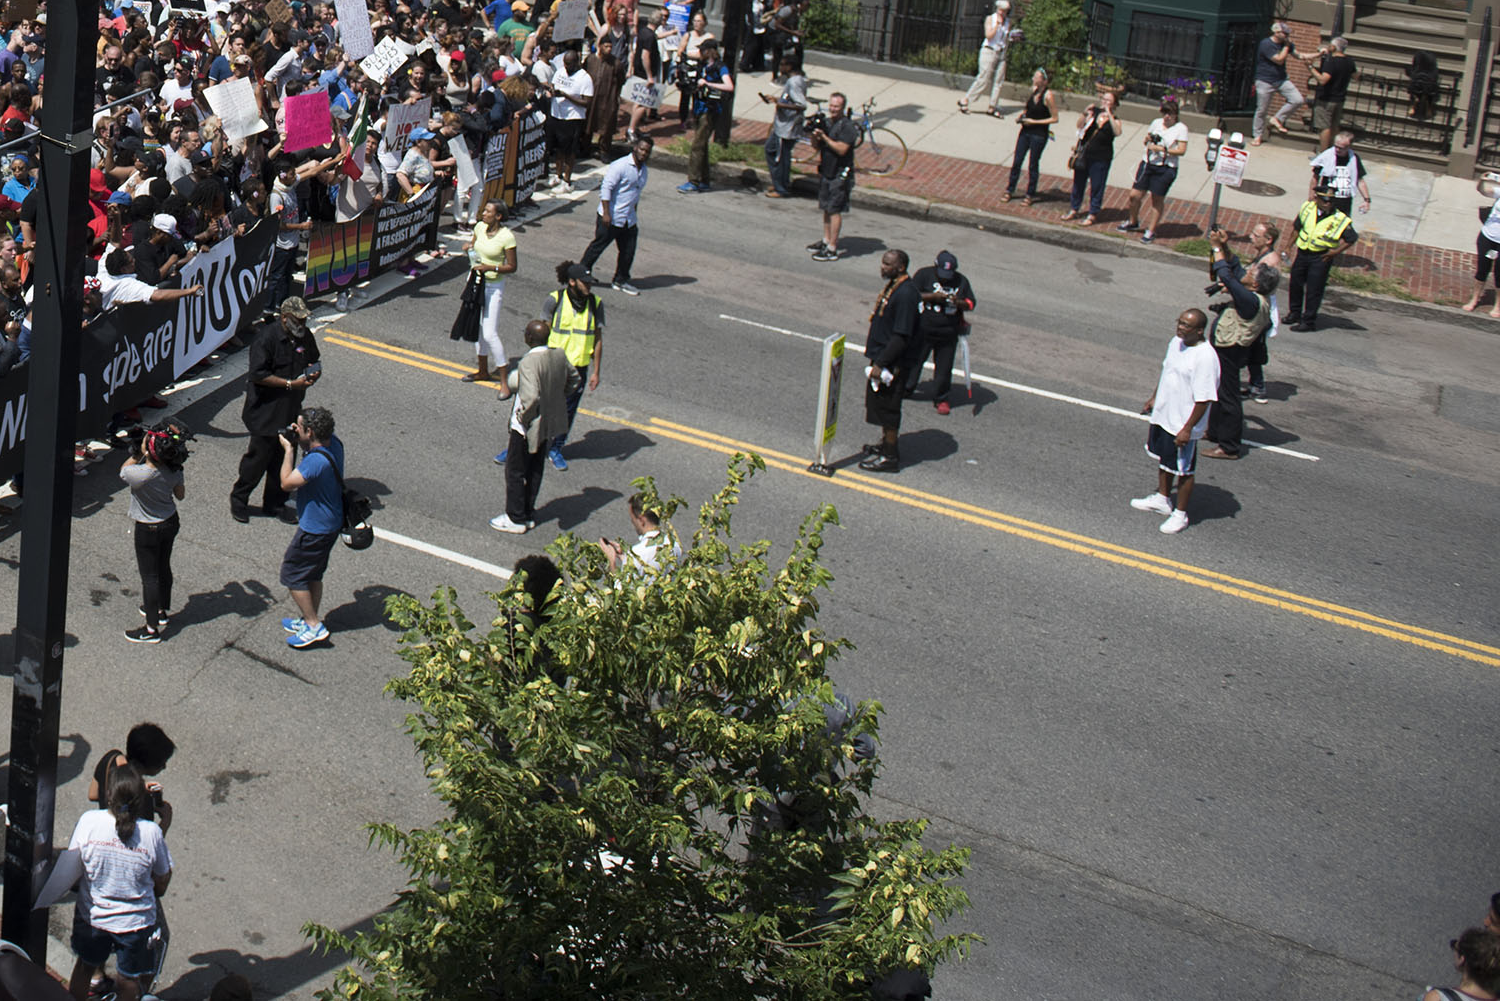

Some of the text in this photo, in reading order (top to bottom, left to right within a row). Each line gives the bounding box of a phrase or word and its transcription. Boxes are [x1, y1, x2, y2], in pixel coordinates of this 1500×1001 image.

[631, 93, 656, 108] FUCK
[396, 121, 421, 137] NOT
[381, 227, 409, 249] FASCIST
[238, 243, 276, 305] on?
[181, 254, 232, 357] YOU
[103, 335, 142, 404] side
[143, 319, 173, 373] are
